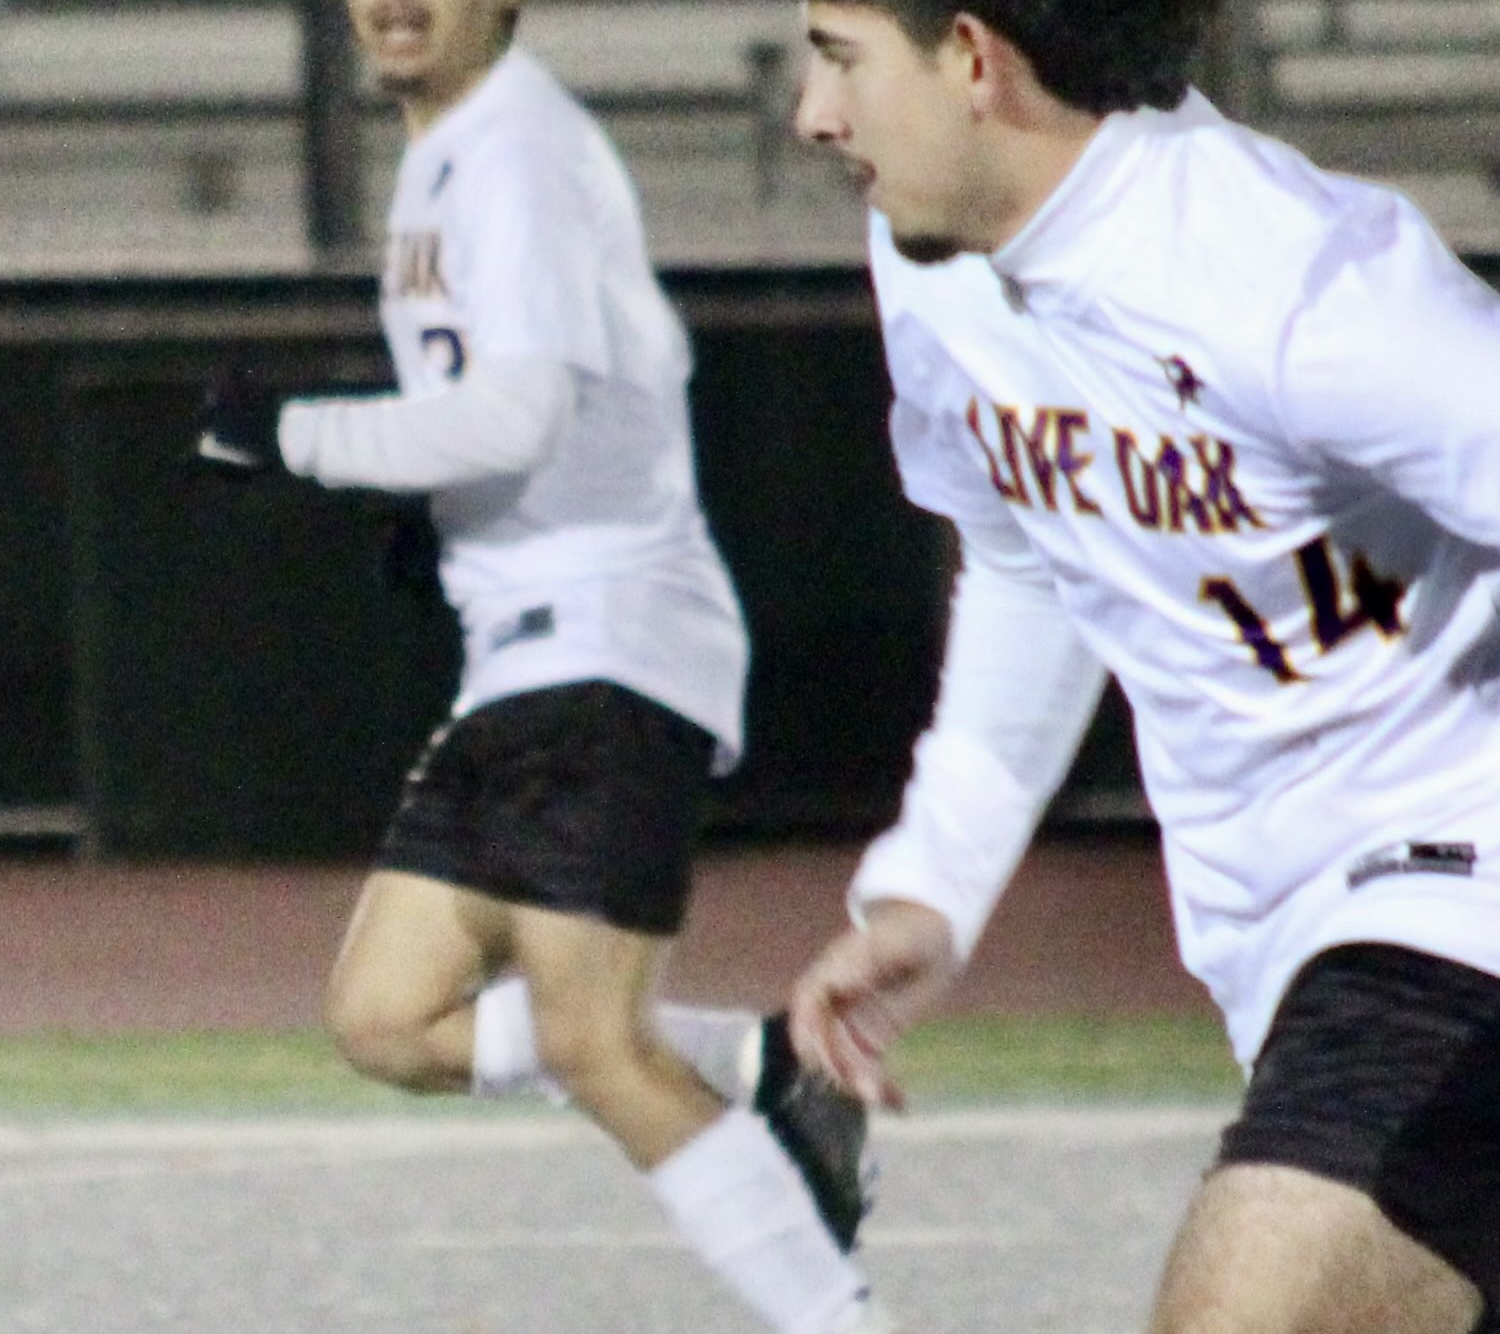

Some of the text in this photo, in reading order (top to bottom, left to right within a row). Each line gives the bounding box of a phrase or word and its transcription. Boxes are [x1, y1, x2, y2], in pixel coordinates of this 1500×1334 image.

[966, 395, 1270, 535] LIVE OAK
[1199, 533, 1410, 685] 14
